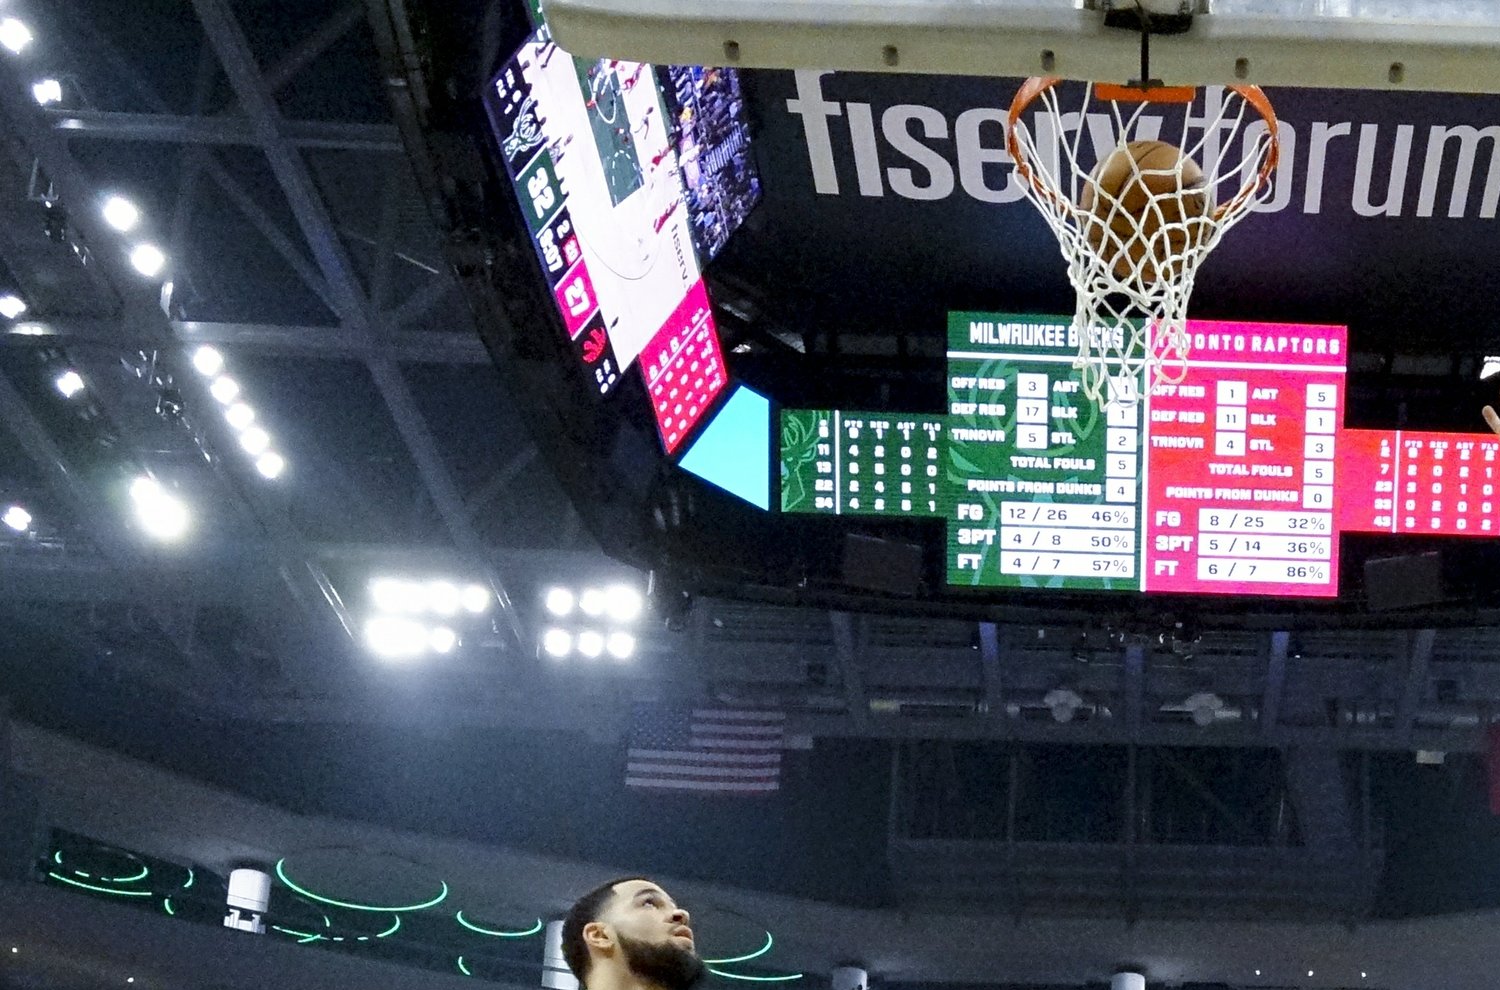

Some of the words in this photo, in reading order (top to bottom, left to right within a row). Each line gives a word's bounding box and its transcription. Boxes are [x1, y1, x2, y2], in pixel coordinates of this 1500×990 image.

[527, 167, 555, 220] 32
[564, 277, 590, 317] 27
[970, 321, 1065, 346] MILWAUKEE
[1068, 326, 1124, 349] BCKS
[1251, 336, 1340, 355] RAPTORS
[951, 377, 976, 389] OFF
[979, 378, 1006, 390] REB
[1028, 382, 1037, 391] 3
[1053, 381, 1079, 393] AST
[1179, 386, 1205, 397] REB
[1252, 388, 1279, 400] AST
[1318, 392, 1326, 402] 5
[951, 403, 976, 415] DEF
[979, 404, 1006, 416] REB
[1025, 407, 1039, 417] 17
[1051, 407, 1078, 418] BLK
[1151, 410, 1176, 422] DEF
[1179, 411, 1205, 423] REB
[1226, 414, 1237, 424] 11
[1250, 414, 1277, 425] BLK
[951, 428, 1005, 442] TRNOVR
[1028, 432, 1037, 442] 5
[1051, 432, 1076, 444] STL
[1118, 436, 1127, 446] 2
[1151, 436, 1204, 449] TRNOVR
[1226, 440, 1234, 450] 4
[1249, 439, 1275, 451] STL
[1315, 443, 1324, 453] 3
[817, 444, 830, 455] 11
[849, 445, 859, 457] 4
[1010, 456, 1051, 469] TOTAL
[1054, 457, 1096, 471] FOULS
[1118, 460, 1126, 470] 5
[1208, 463, 1250, 476] TOTAL
[1252, 464, 1293, 477] FOULS
[1315, 468, 1323, 478] 5
[967, 479, 1015, 492] POINTS
[1017, 481, 1054, 494] FROM
[1056, 482, 1102, 495] DUNKS
[1117, 486, 1125, 495] 4
[1166, 486, 1213, 499] POINTS
[1215, 488, 1251, 501] FROM
[1253, 489, 1298, 502] DUNKS
[1314, 493, 1322, 503] 0
[957, 504, 983, 520] FG
[1009, 508, 1026, 519] 12
[1047, 509, 1067, 521] 26
[1091, 510, 1129, 524] 46%
[1155, 511, 1181, 527] FG
[1210, 515, 1219, 526] 8
[1244, 516, 1264, 527] 25
[1288, 517, 1325, 530] 32%
[957, 529, 997, 545] 3PT
[1012, 533, 1022, 544] 4
[1052, 535, 1061, 545] 8
[1091, 535, 1128, 548] 50%
[1155, 535, 1193, 551] 3PT
[1209, 539, 1218, 550] 5
[1245, 540, 1261, 551] 14
[1287, 542, 1324, 554] 36%
[957, 553, 982, 570] FT
[1012, 557, 1022, 568] 4
[1052, 559, 1061, 569] 7
[1092, 560, 1128, 573] 57%
[1154, 560, 1179, 576] FT
[1208, 564, 1217, 575] 6
[1249, 565, 1257, 575] 7
[1287, 566, 1323, 579] 86%
